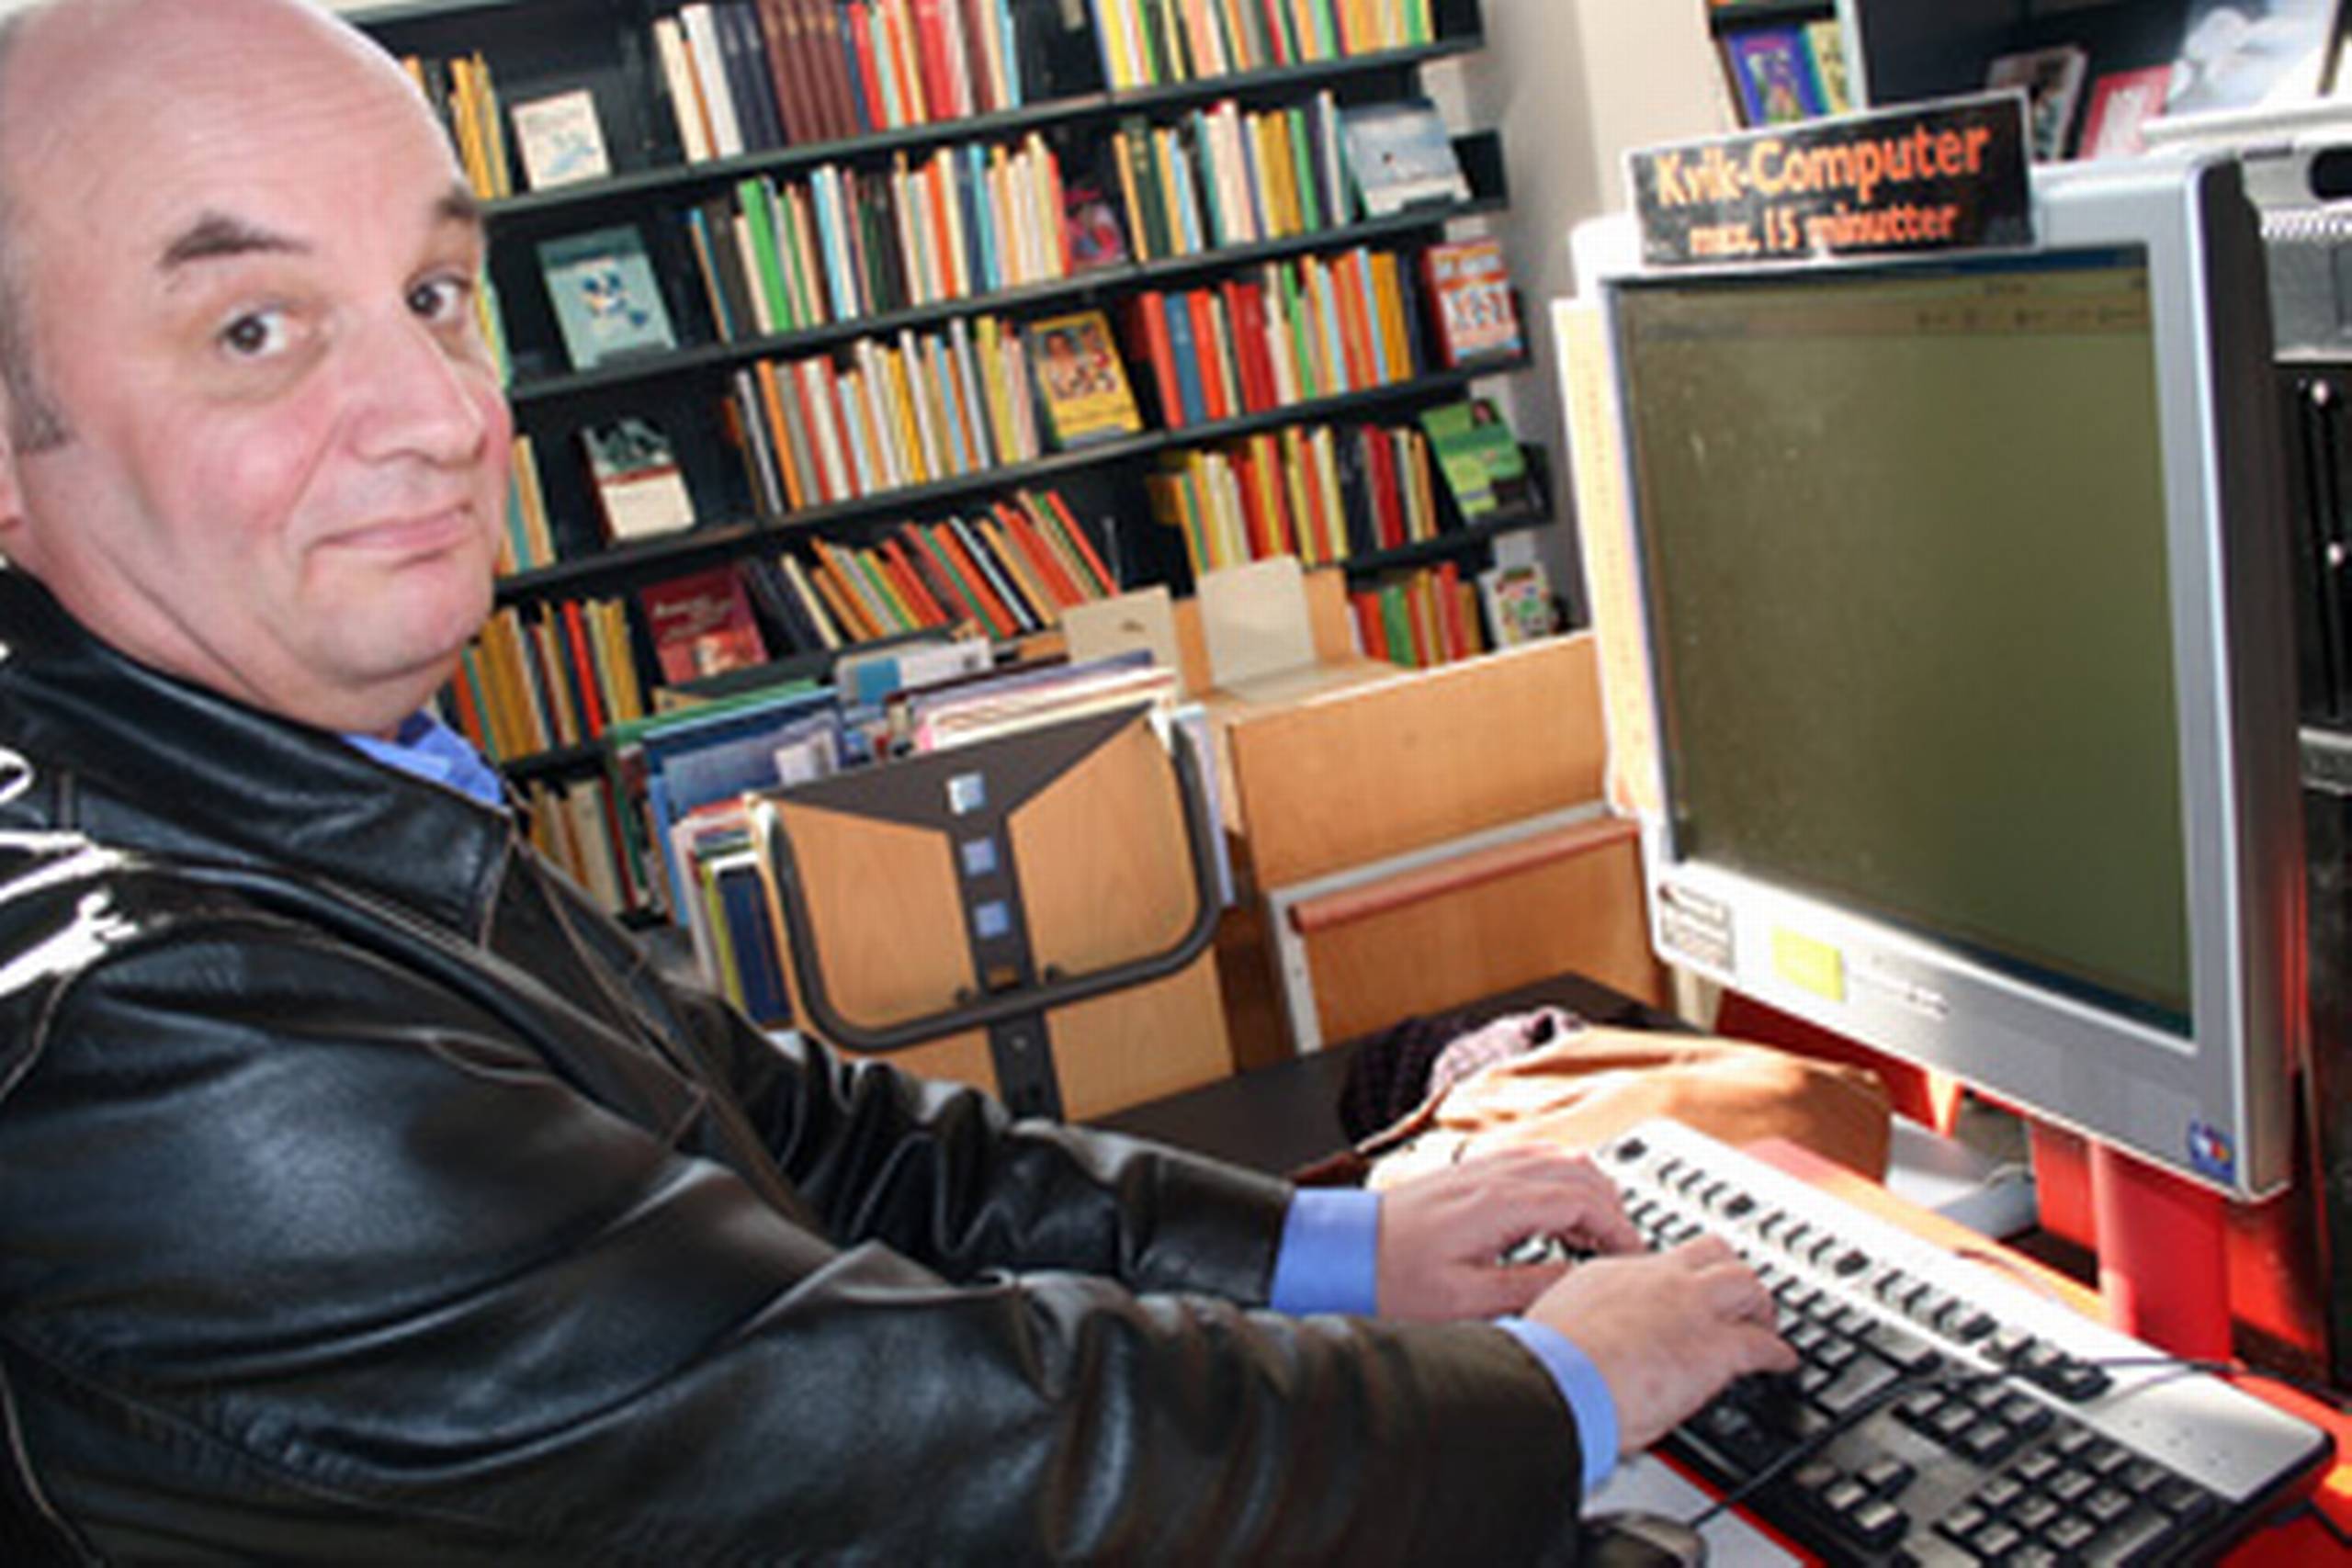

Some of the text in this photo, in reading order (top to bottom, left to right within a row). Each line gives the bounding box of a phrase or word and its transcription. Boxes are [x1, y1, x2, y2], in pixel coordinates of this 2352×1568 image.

[1656, 123, 1991, 206] Kvik-Computer
[1764, 204, 1801, 251] 15
[1804, 201, 1959, 249] minutter
